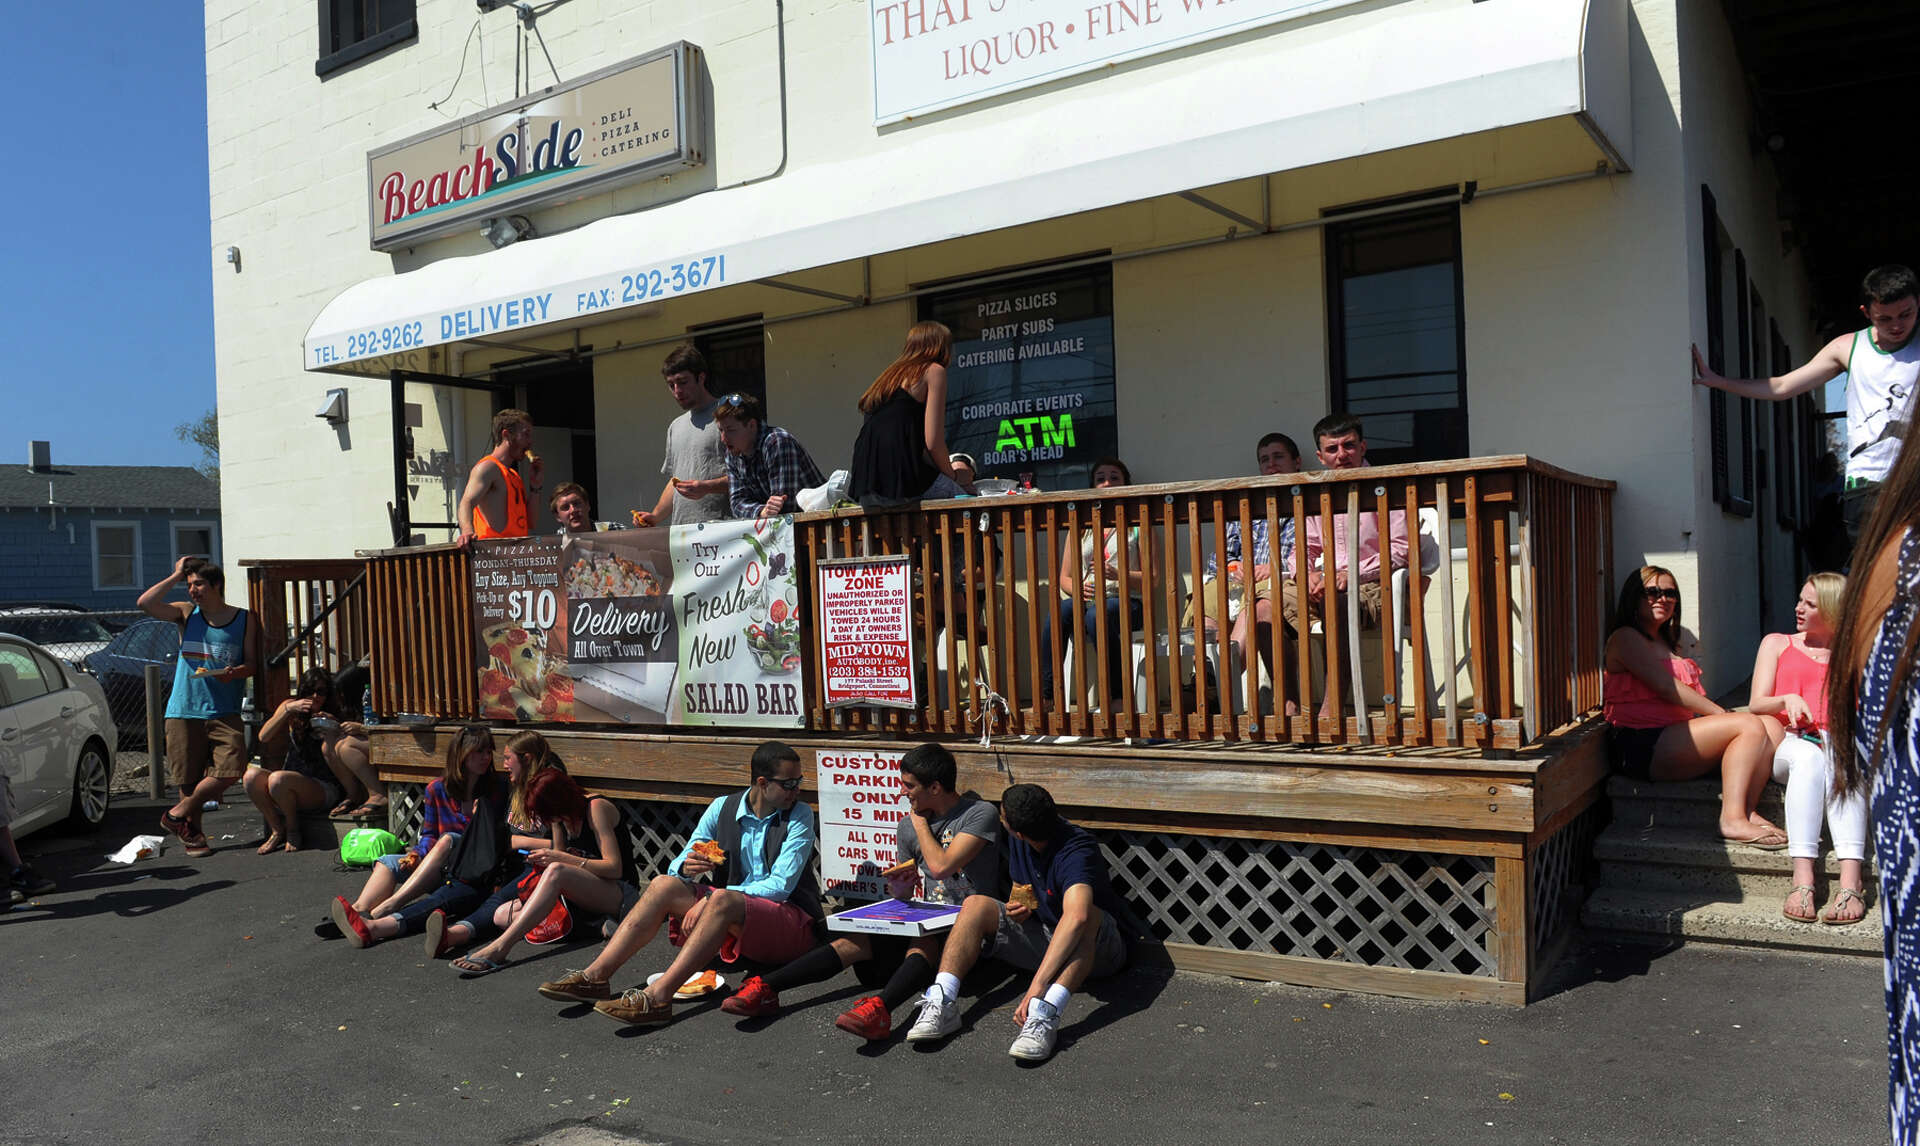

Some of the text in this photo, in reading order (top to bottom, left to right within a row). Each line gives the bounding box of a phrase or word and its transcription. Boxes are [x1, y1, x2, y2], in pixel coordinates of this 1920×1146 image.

[943, 0, 1162, 80] LIQUOR FINE
[600, 107, 633, 126] DELI
[601, 122, 640, 141] PIZZA
[601, 128, 671, 157] CATERING
[315, 346, 344, 364] TEL.
[348, 321, 424, 358] 292-9262
[440, 293, 552, 340] DELIVERY
[577, 288, 615, 312] FAX:
[621, 254, 725, 303] 292-3671
[978, 292, 1057, 317] PIZZA SLICES
[982, 318, 1055, 342] PARTY SUBS
[958, 337, 1084, 368] CATERING AVAILABLE
[962, 393, 1083, 420] CORPORATE EVENTS
[995, 414, 1076, 453] ATM
[984, 445, 1064, 465] BOAR'S HEAD
[495, 545, 534, 555] PIZZA
[692, 543, 719, 559] Try
[474, 556, 558, 569] MONDAY-THURSDAY
[694, 563, 720, 577] Our
[475, 569, 558, 589] Any Size, Any Topping
[825, 564, 902, 579] TOW AWAY
[845, 577, 884, 590] ZONE
[683, 575, 748, 627] Fresh
[827, 590, 889, 600] UNAUTHORIZED
[508, 589, 557, 629] $10
[827, 598, 905, 608] IMPROPERLY PARKED
[483, 606, 504, 619] Delivery
[829, 608, 868, 616] VEHICLES
[870, 607, 889, 615] WILL
[573, 602, 670, 651] Delivery
[831, 617, 859, 625] TOWED
[838, 625, 854, 633] DAY
[867, 624, 902, 632] OWNERS
[863, 633, 900, 641] EXPENSE
[574, 640, 645, 658] All Over Town
[689, 633, 736, 670] New
[829, 667, 855, 676] (203)
[685, 683, 799, 715] SALAD BAR
[821, 756, 902, 770] CUSTOM
[833, 773, 903, 788] PARKIN
[852, 792, 901, 805] ONLY
[842, 808, 862, 820] 15
[848, 831, 897, 845] ALL OTH
[838, 846, 868, 860] CARS
[826, 878, 877, 893] OWNER'S
